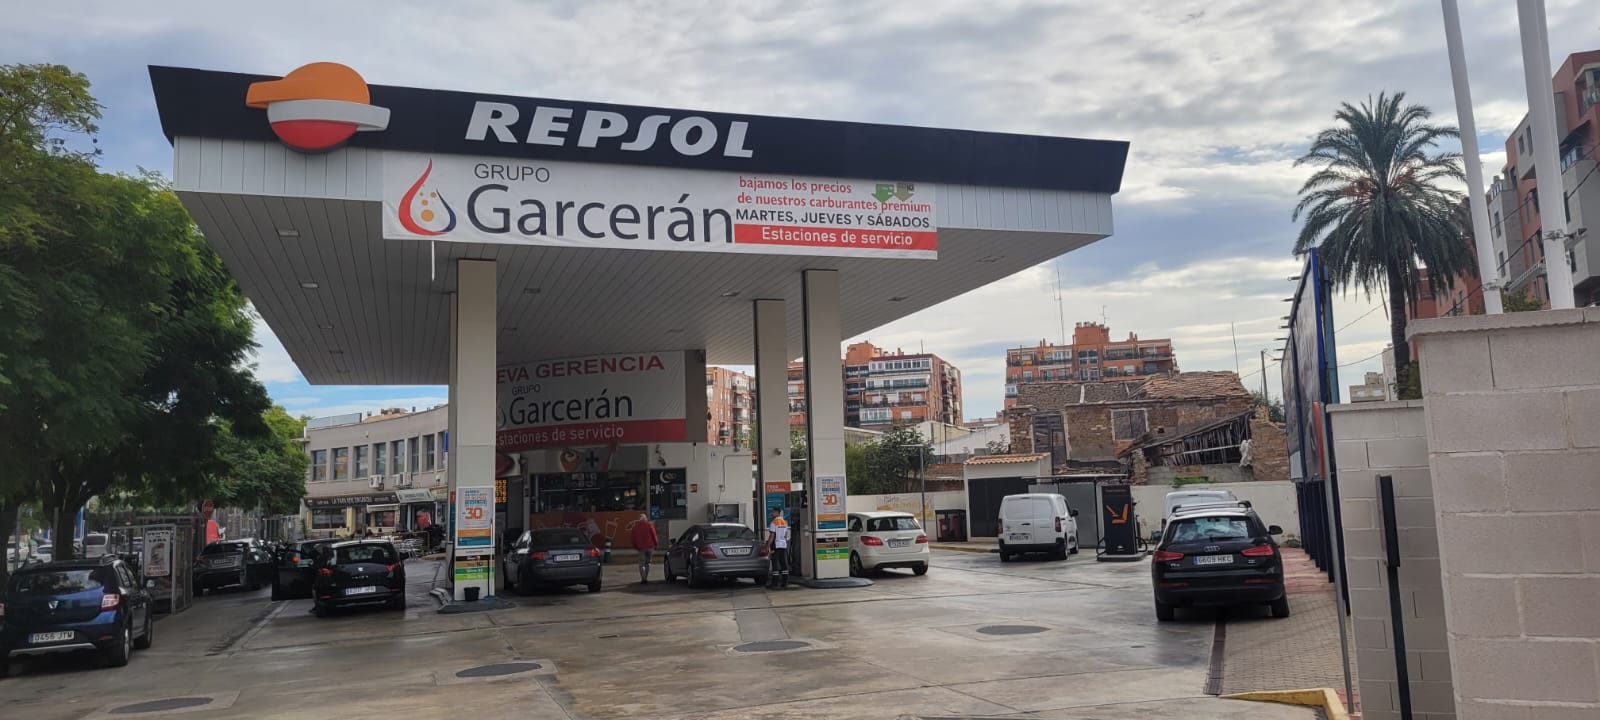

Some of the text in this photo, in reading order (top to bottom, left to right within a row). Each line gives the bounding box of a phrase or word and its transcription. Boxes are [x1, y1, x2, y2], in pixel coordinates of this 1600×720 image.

[465, 100, 755, 158] REPSOL
[474, 163, 551, 184] GRUPO
[739, 176, 852, 194] bajamos los precios
[737, 192, 931, 213] de nuestros carburantes premium
[466, 183, 734, 244] Garcerán
[735, 209, 930, 228] MARTES, JUEVES Y SÁBADOS
[762, 226, 913, 246] Estaciones de servicio
[496, 355, 665, 385] EVA GERENCIA
[511, 383, 541, 396] GRUPO
[509, 388, 633, 425] Garcerán
[552, 426, 566, 442] de
[569, 424, 624, 440] servicio
